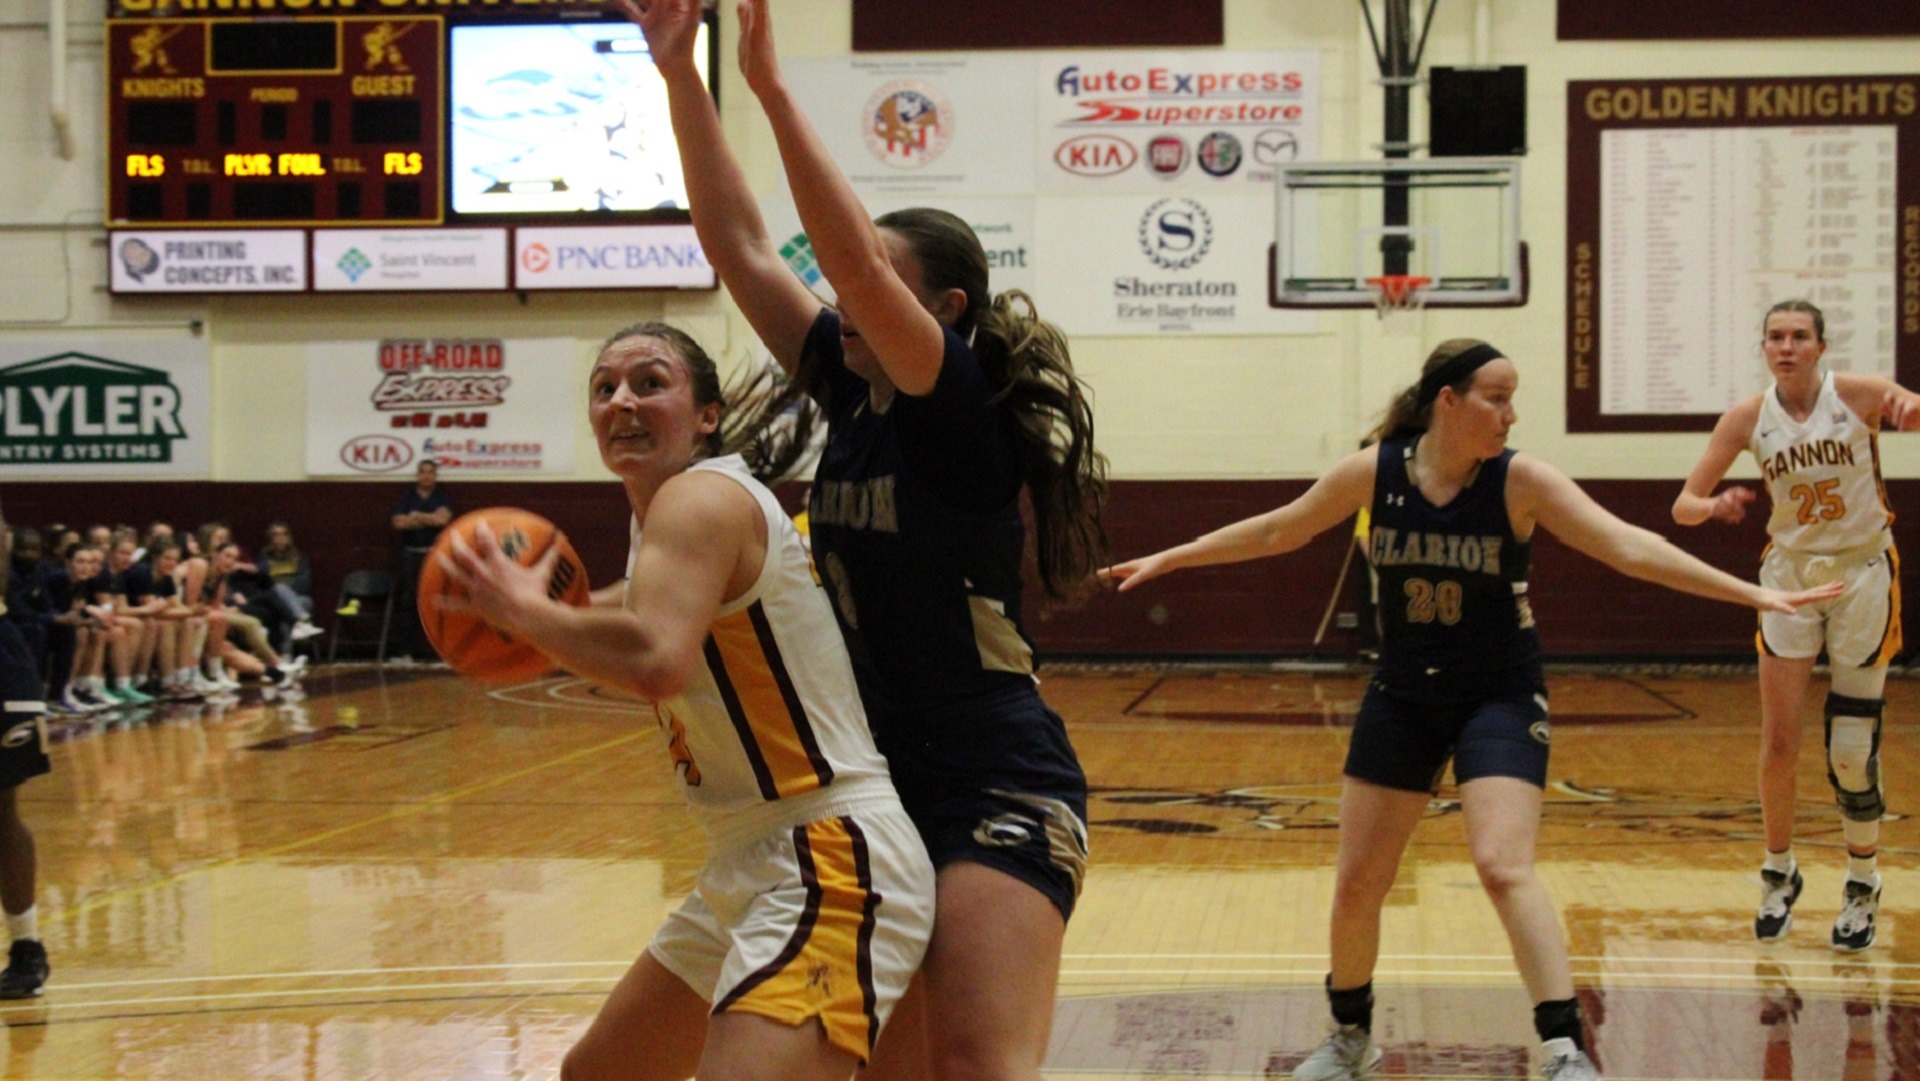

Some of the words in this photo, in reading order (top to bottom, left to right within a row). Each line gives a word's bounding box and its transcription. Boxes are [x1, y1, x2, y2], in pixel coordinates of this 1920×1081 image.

[122, 77, 205, 98] KNIGHTS
[352, 75, 416, 97] GUEST
[1585, 86, 1737, 120] GOLDEN
[1746, 83, 1917, 119] KNIGHTS
[126, 154, 165, 177] FLS
[224, 153, 272, 176] PLYR
[278, 152, 327, 176] FOUL
[383, 152, 423, 176] FLS
[1069, 144, 1123, 167] KIA
[164, 240, 246, 260] PRINTING
[379, 252, 418, 267] Saint
[421, 252, 476, 267] Vincent
[557, 244, 625, 271] PNC
[626, 242, 705, 269] BANK
[263, 265, 298, 285] INC.
[1114, 277, 1238, 298] Sheraton
[1117, 303, 1153, 319] Erie
[1156, 303, 1236, 322] Bayfront
[1574, 242, 1592, 389] SCHEDULE
[378, 340, 505, 371] OFF-ROAD
[0, 385, 181, 436] LYLER
[62, 444, 162, 459] SYSTEMS
[353, 444, 401, 464] KIA
[1789, 477, 1847, 527] 25
[1371, 525, 1503, 576] CLARION
[1403, 577, 1463, 626] 20
